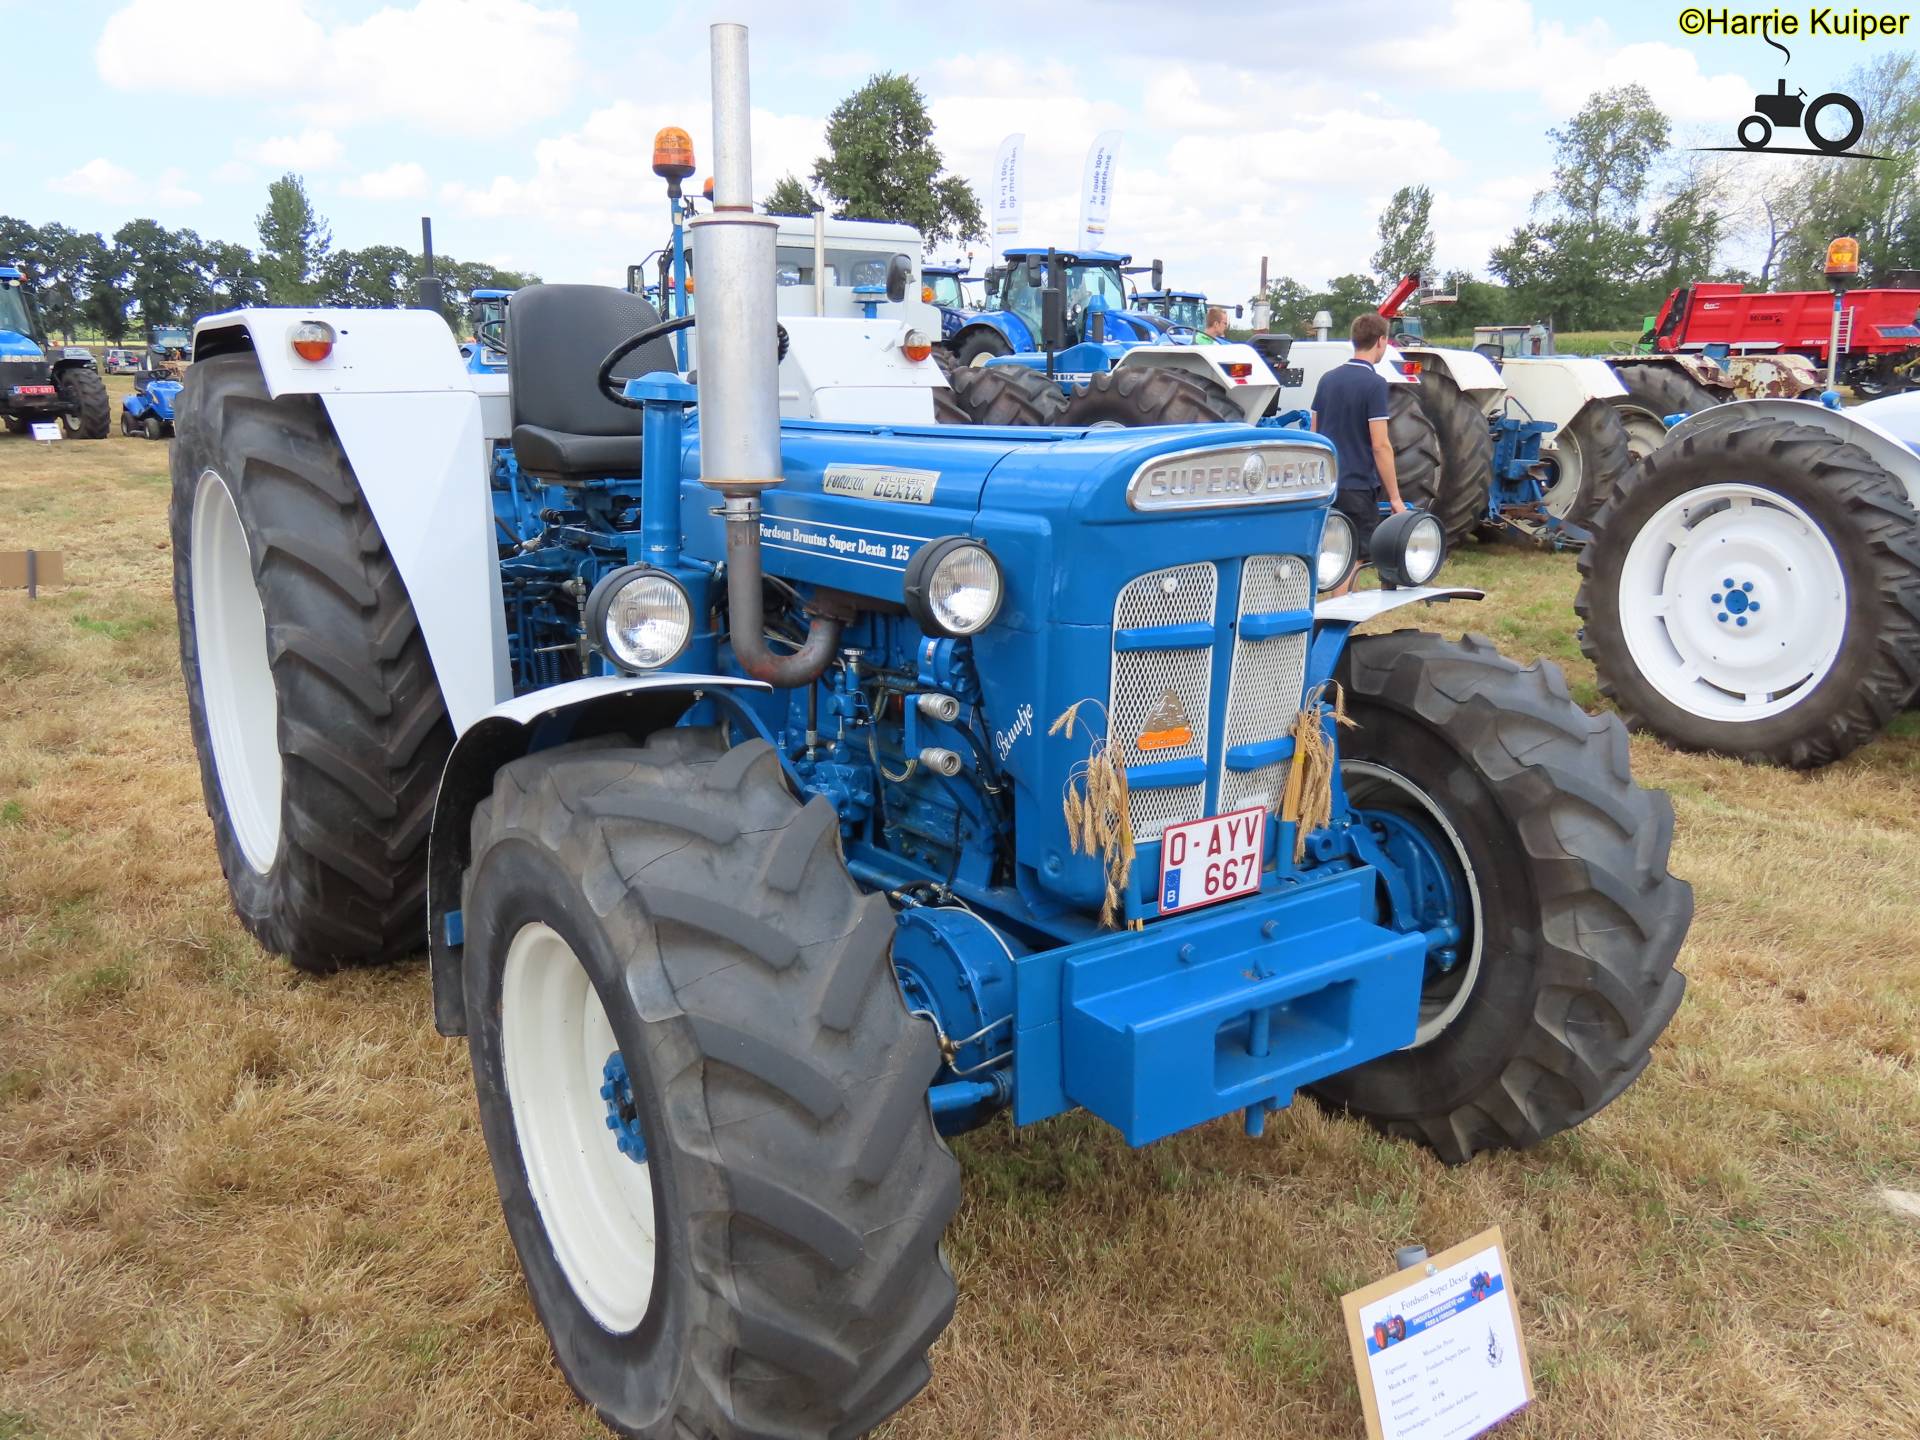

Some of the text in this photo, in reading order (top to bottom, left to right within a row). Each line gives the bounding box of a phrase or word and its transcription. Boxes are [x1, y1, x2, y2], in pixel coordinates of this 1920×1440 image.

[826, 475, 866, 491] FORDSON
[880, 475, 926, 485] SUPER
[1150, 460, 1325, 496] SUPER DEXTA
[873, 482, 923, 501] DEXTA
[760, 523, 910, 561] Fordson Bruutus Super Dexta 125
[1204, 852, 1256, 897] 667
[1167, 890, 1177, 903] B
[1401, 1293, 1429, 1310] Fordson
[1429, 1284, 1448, 1296] Super
